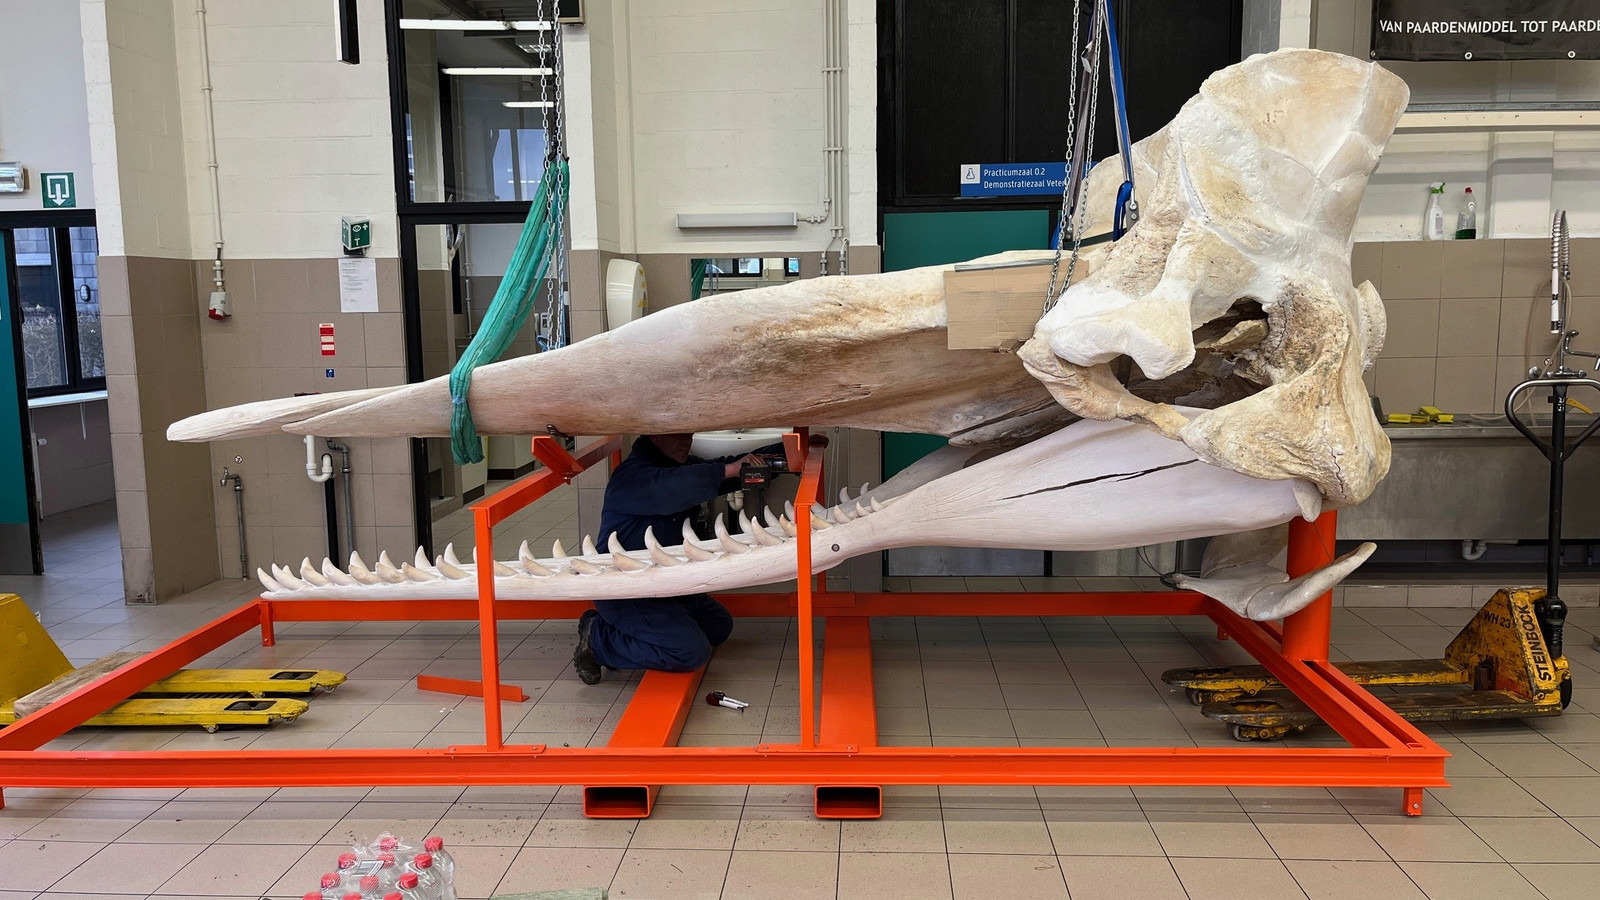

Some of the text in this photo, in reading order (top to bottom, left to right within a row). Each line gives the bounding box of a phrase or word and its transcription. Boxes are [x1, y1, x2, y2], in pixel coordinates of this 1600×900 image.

[1379, 19, 1402, 33] VAN
[1406, 21, 1517, 34] PAARDENMIDDEL
[1520, 20, 1548, 33] TOT
[984, 168, 1033, 177] Practicumzaal
[984, 179, 1045, 189] Demonstratiezaal
[1483, 611, 1511, 629] WH 23
[1518, 604, 1552, 681] STEINBOCK
